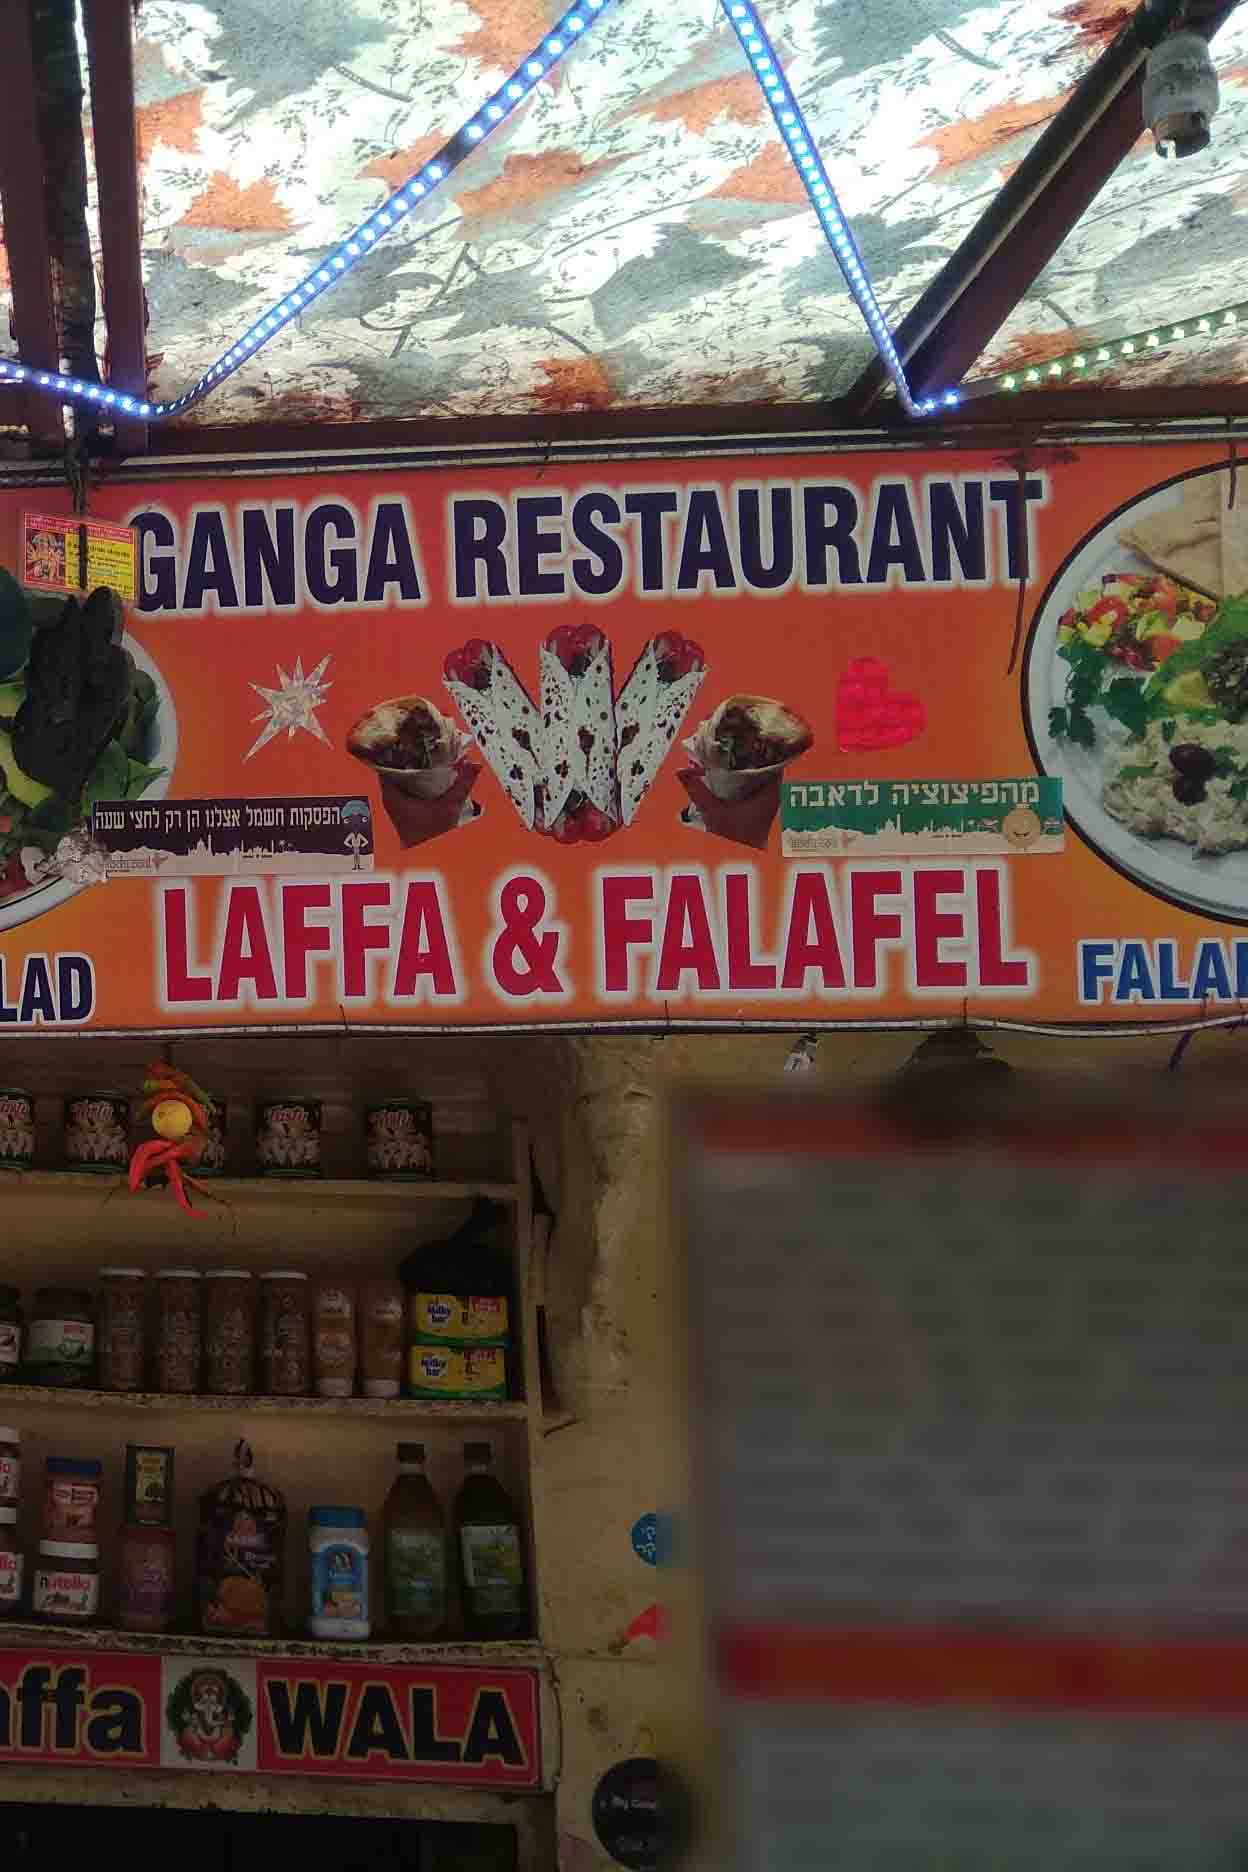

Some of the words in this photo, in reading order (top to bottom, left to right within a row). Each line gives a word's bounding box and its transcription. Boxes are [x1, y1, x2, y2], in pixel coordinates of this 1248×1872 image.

[128, 500, 424, 613] GANGA
[452, 478, 1044, 600] RESTAURANT
[95, 809, 124, 830] שעה
[130, 807, 160, 829] לחצי
[165, 809, 181, 833] רק
[186, 809, 201, 833] הן
[205, 806, 240, 829] אצלנו
[246, 805, 284, 827] חשמל
[290, 805, 340, 830] הפסקות
[162, 876, 457, 1002] LAFFA
[492, 876, 563, 995] &
[602, 868, 1030, 993] FALAFEL
[265, 1679, 527, 1767] WALA
